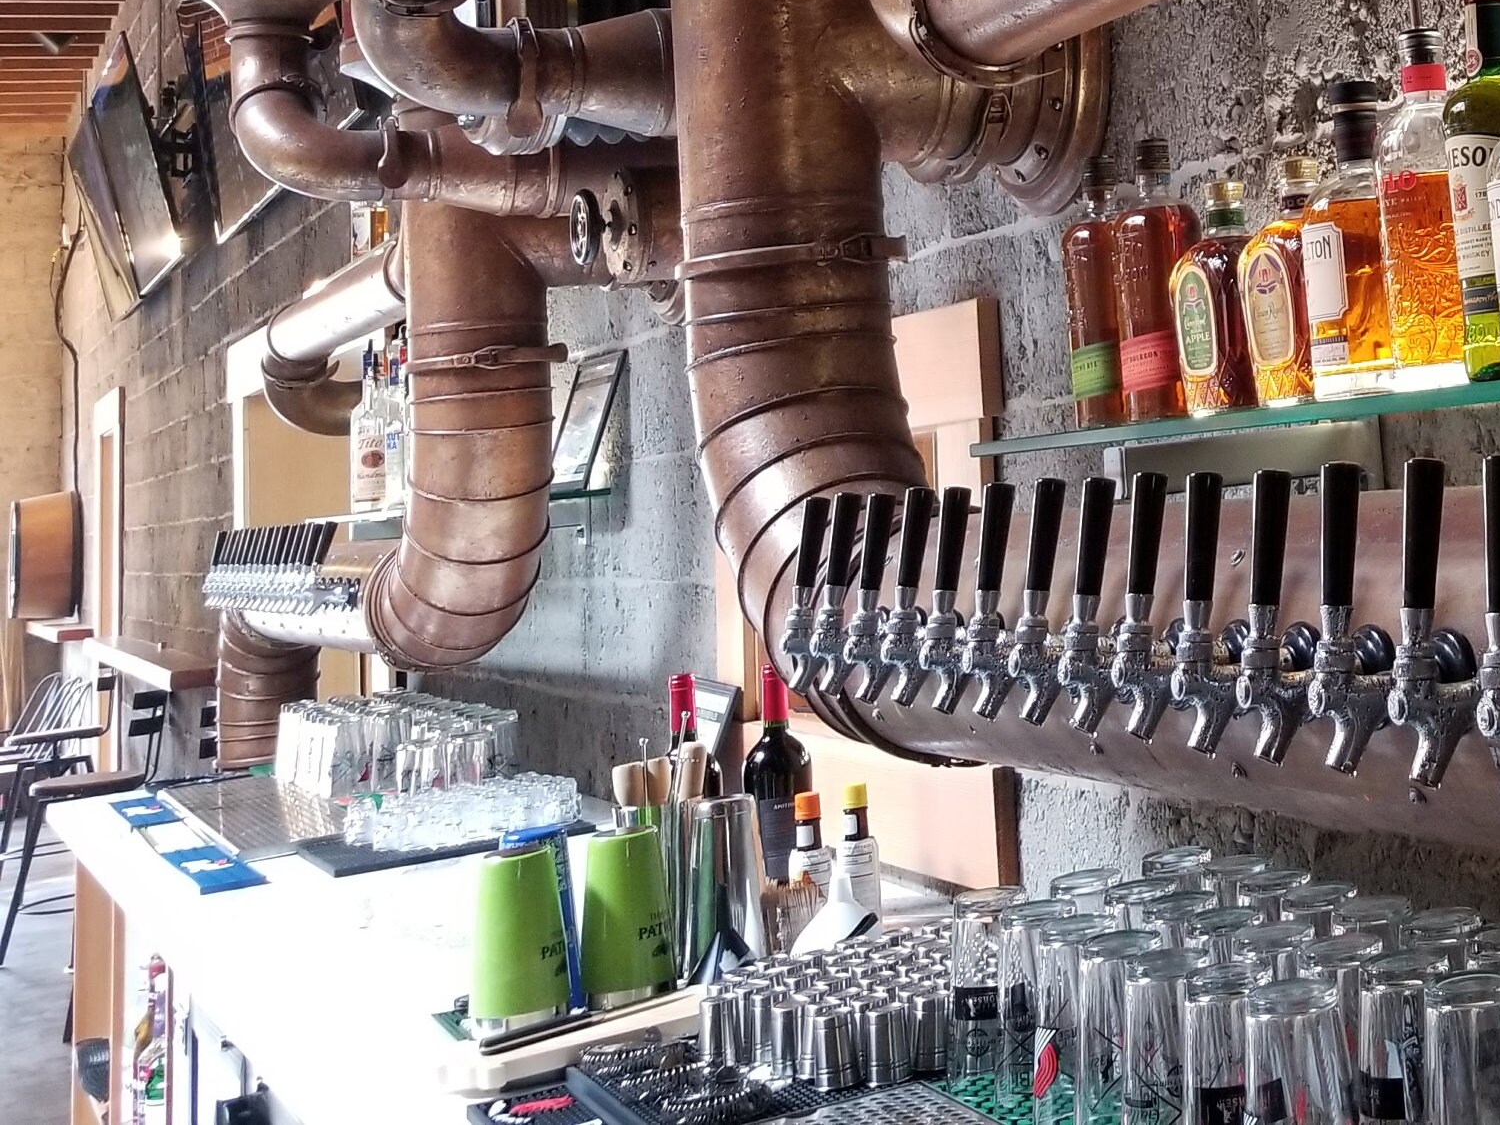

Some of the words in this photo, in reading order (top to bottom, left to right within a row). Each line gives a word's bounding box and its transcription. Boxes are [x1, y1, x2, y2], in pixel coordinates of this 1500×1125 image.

[1185, 331, 1211, 345] APPLE
[357, 437, 383, 450] Tito
[541, 939, 567, 960] PAT
